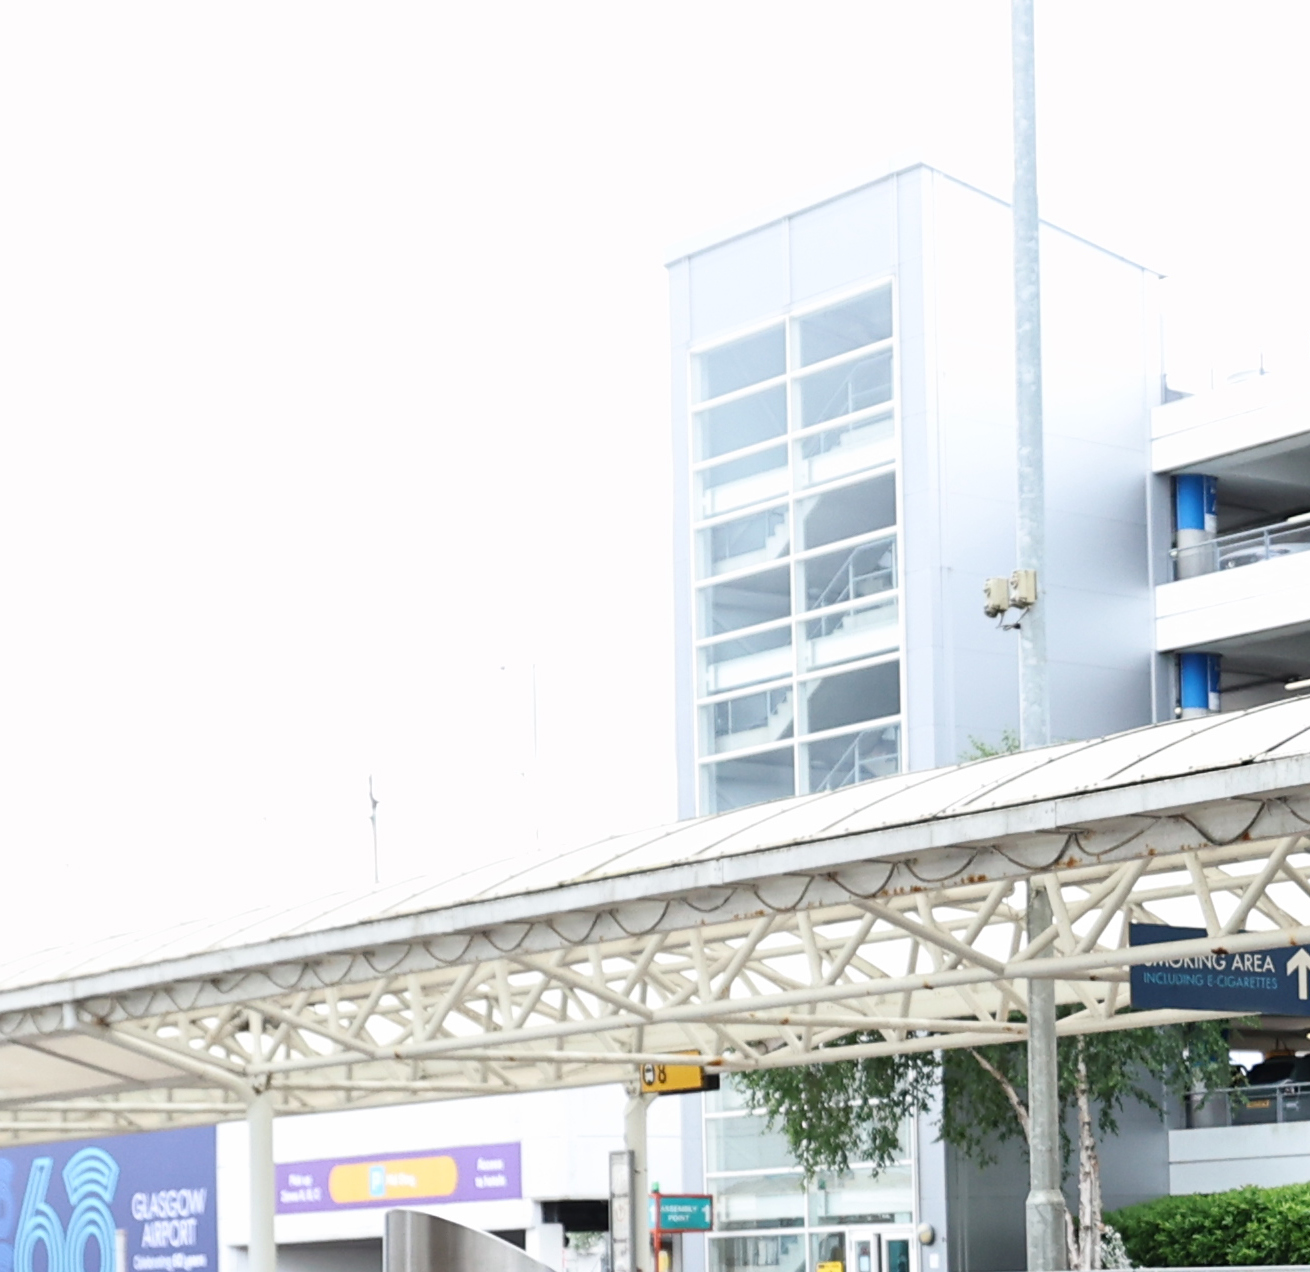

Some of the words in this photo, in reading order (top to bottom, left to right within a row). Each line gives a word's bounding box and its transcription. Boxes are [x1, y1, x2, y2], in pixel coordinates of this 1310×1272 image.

[1231, 953, 1276, 973] AREA
[1143, 972, 1202, 986] INCLUDING
[1207, 976, 1279, 990] E-CIGARETTES
[131, 1187, 208, 1221] GLASGOW
[661, 1205, 698, 1213] ASSEMBLY
[667, 1214, 690, 1222] POINT
[141, 1217, 197, 1248] AIRPORT
